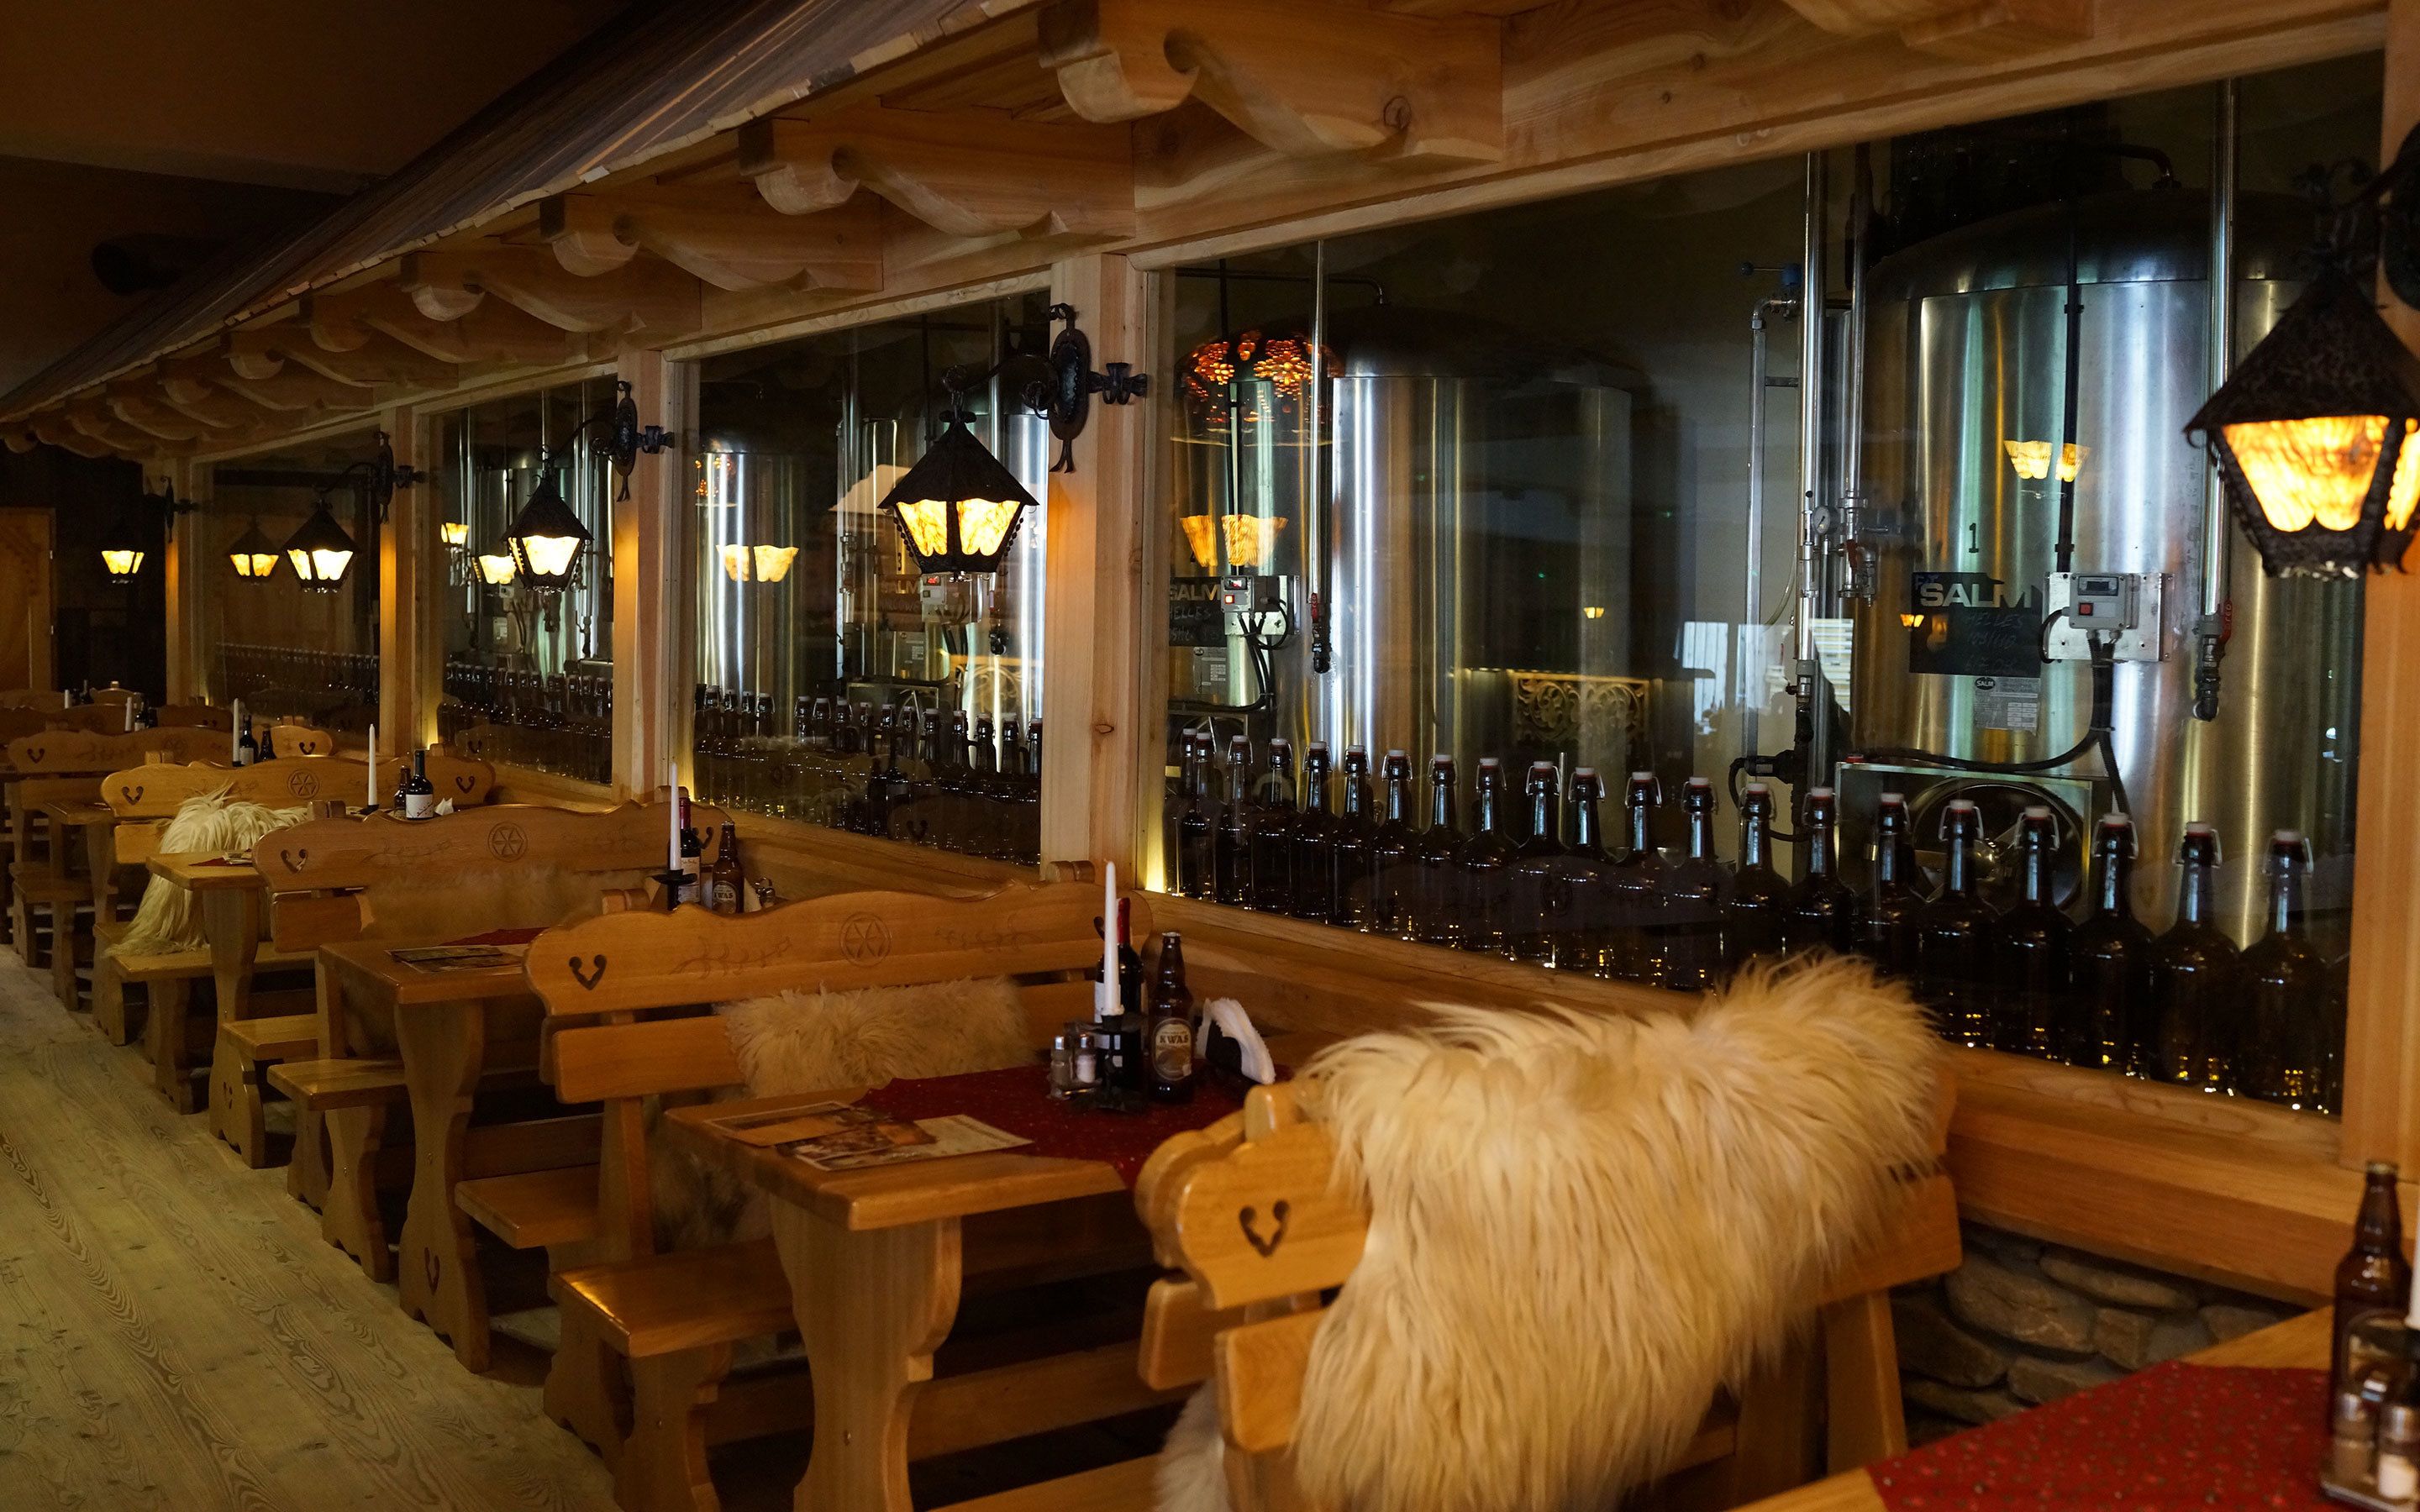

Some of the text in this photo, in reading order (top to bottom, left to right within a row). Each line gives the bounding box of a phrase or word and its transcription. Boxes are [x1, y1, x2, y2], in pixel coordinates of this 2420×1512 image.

[1969, 523, 1979, 553] 1
[1920, 583, 2032, 608] SALM
[1160, 1034, 1189, 1043] KWAS
